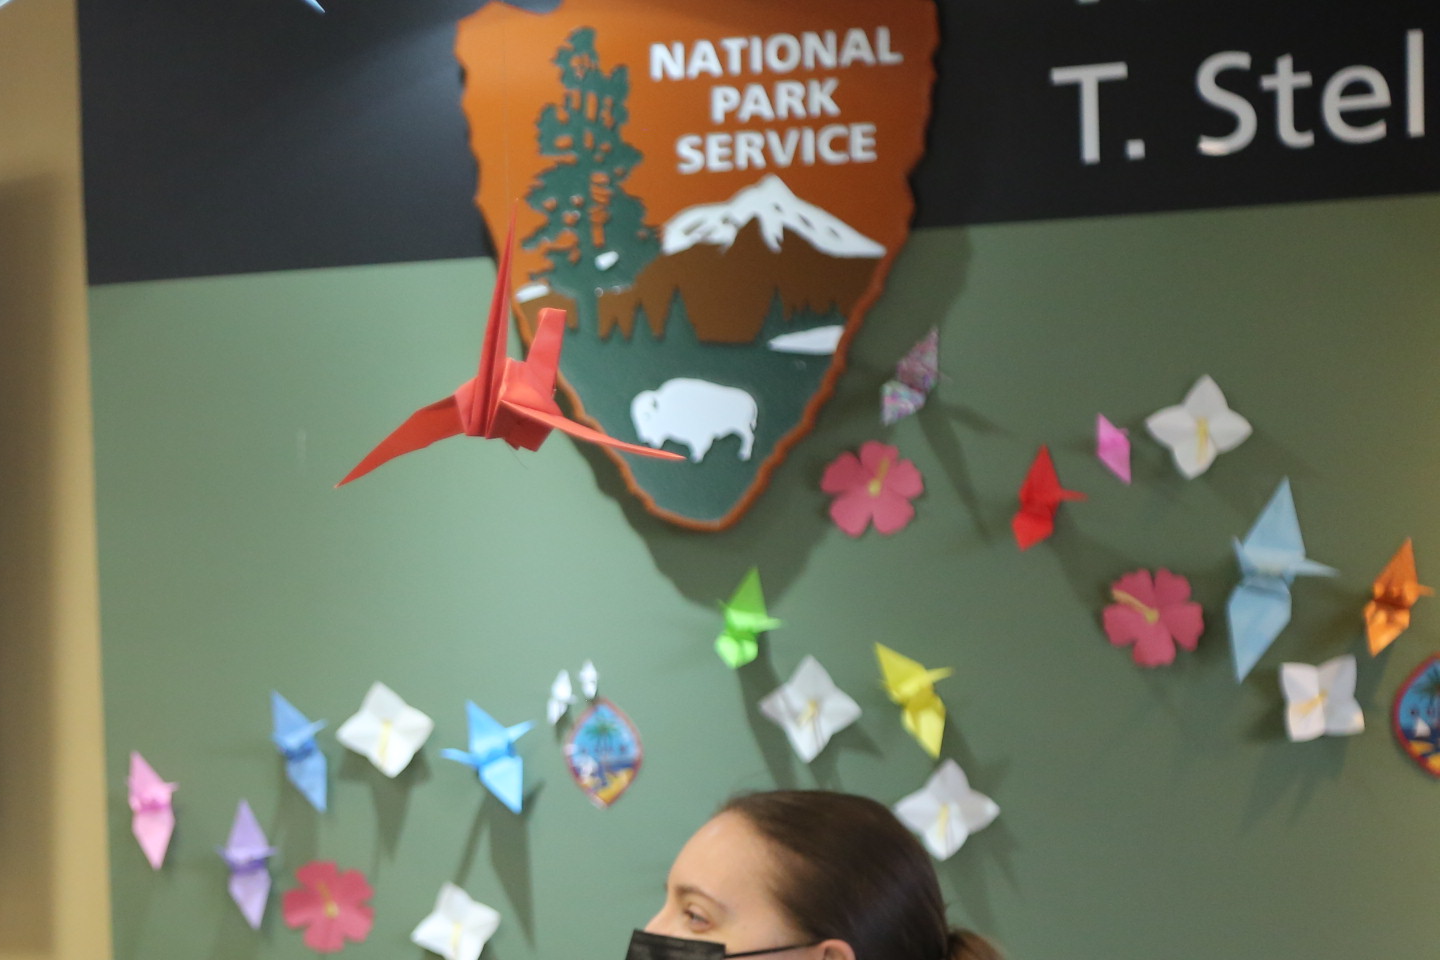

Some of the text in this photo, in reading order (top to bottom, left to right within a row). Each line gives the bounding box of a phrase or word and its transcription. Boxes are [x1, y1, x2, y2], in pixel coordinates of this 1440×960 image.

[649, 25, 904, 82] NATIONAL
[710, 76, 841, 125] PARK
[1049, 28, 1426, 165] T. Stel
[675, 122, 878, 175] SERVICE
